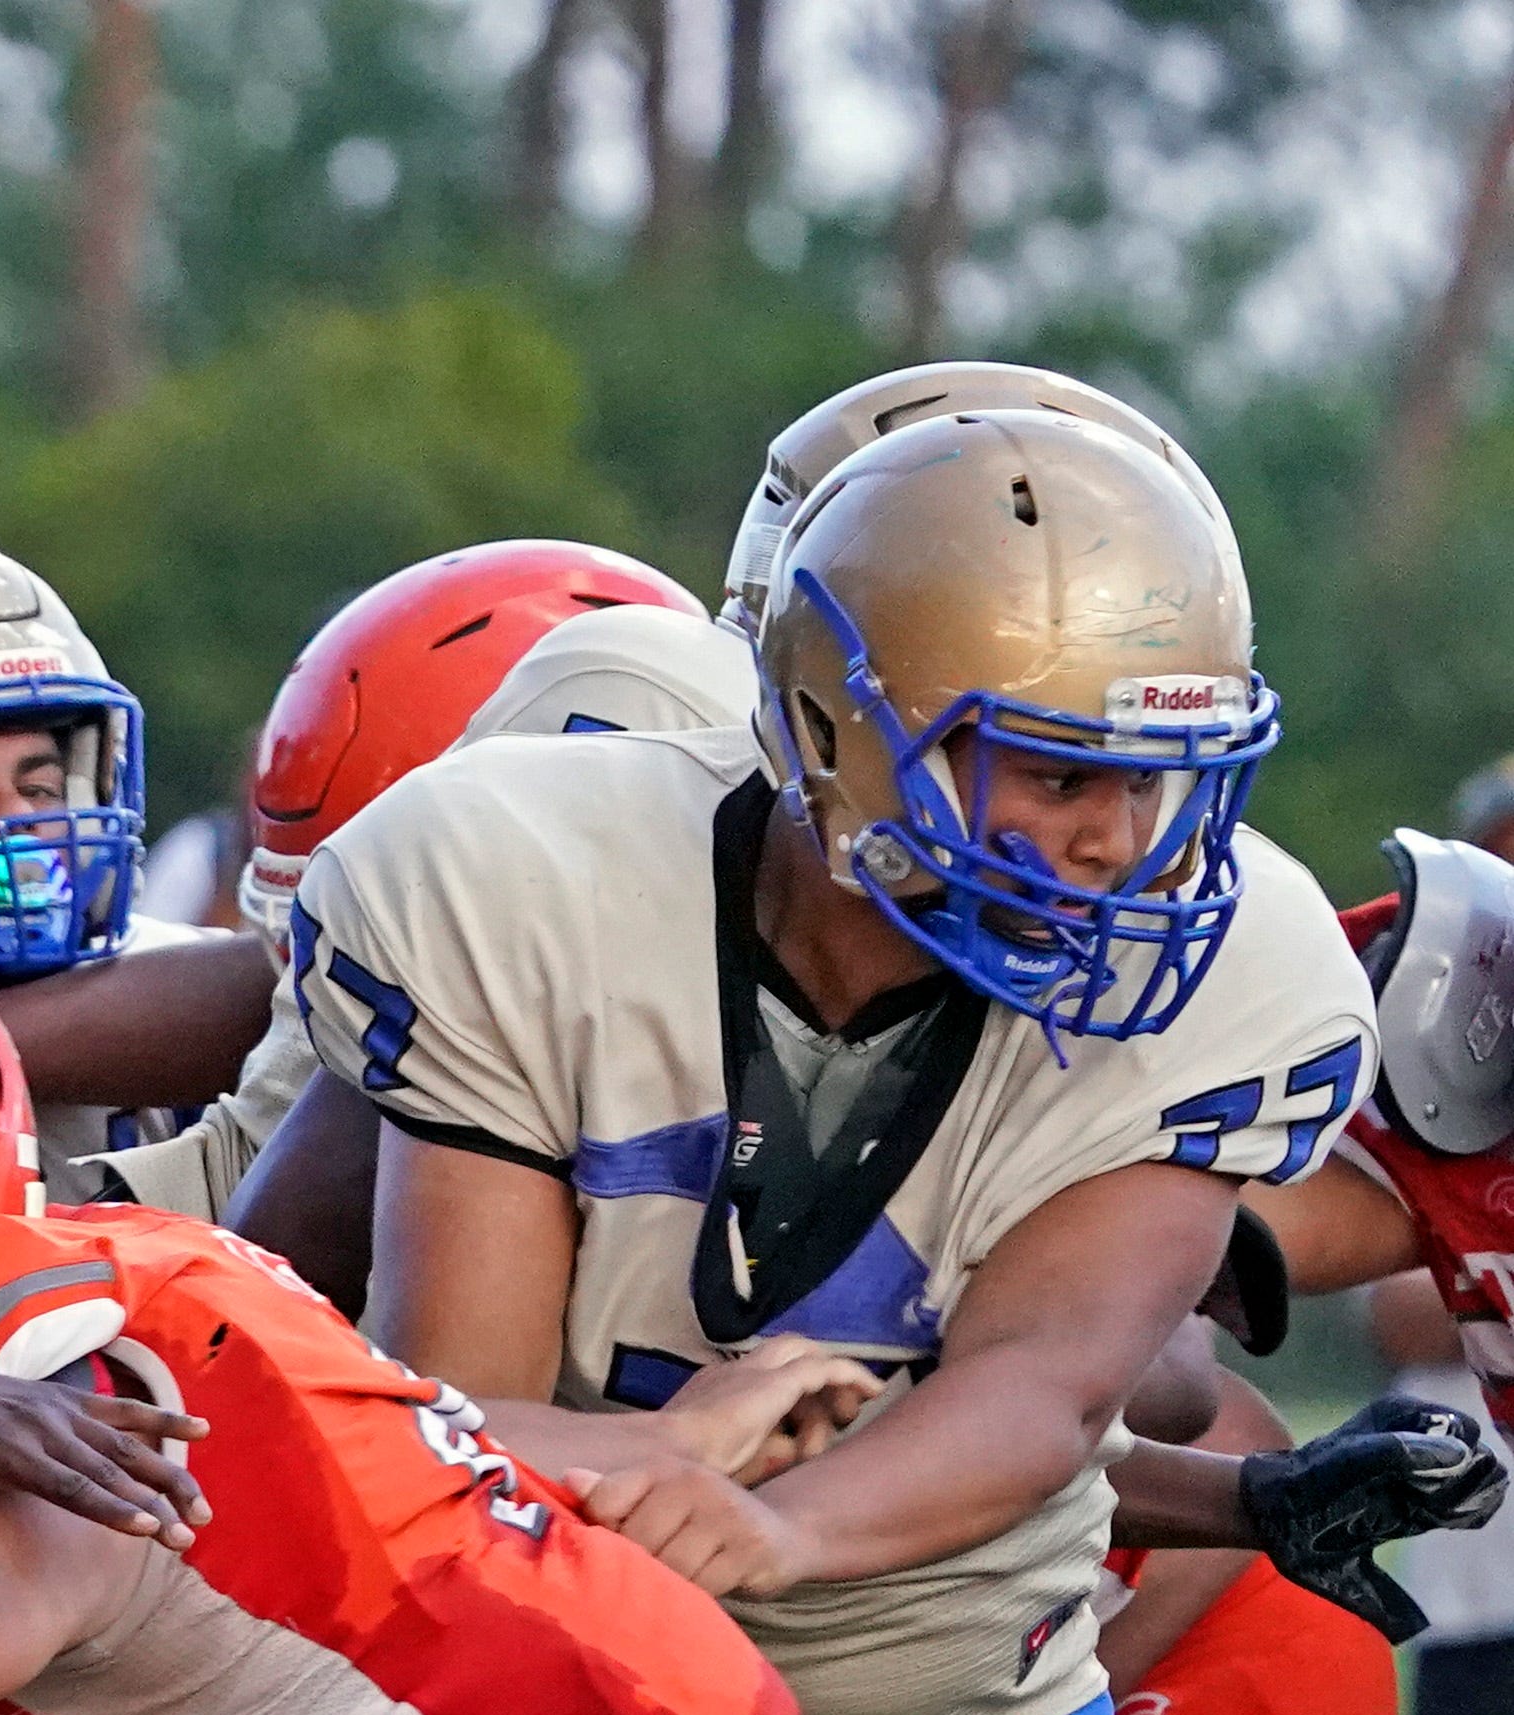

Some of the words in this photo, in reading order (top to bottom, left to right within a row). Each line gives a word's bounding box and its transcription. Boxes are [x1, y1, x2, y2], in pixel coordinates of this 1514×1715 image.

[1142, 684, 1215, 710] Riddell
[1003, 953, 1061, 974] Riddell
[1159, 1033, 1363, 1186] 77
